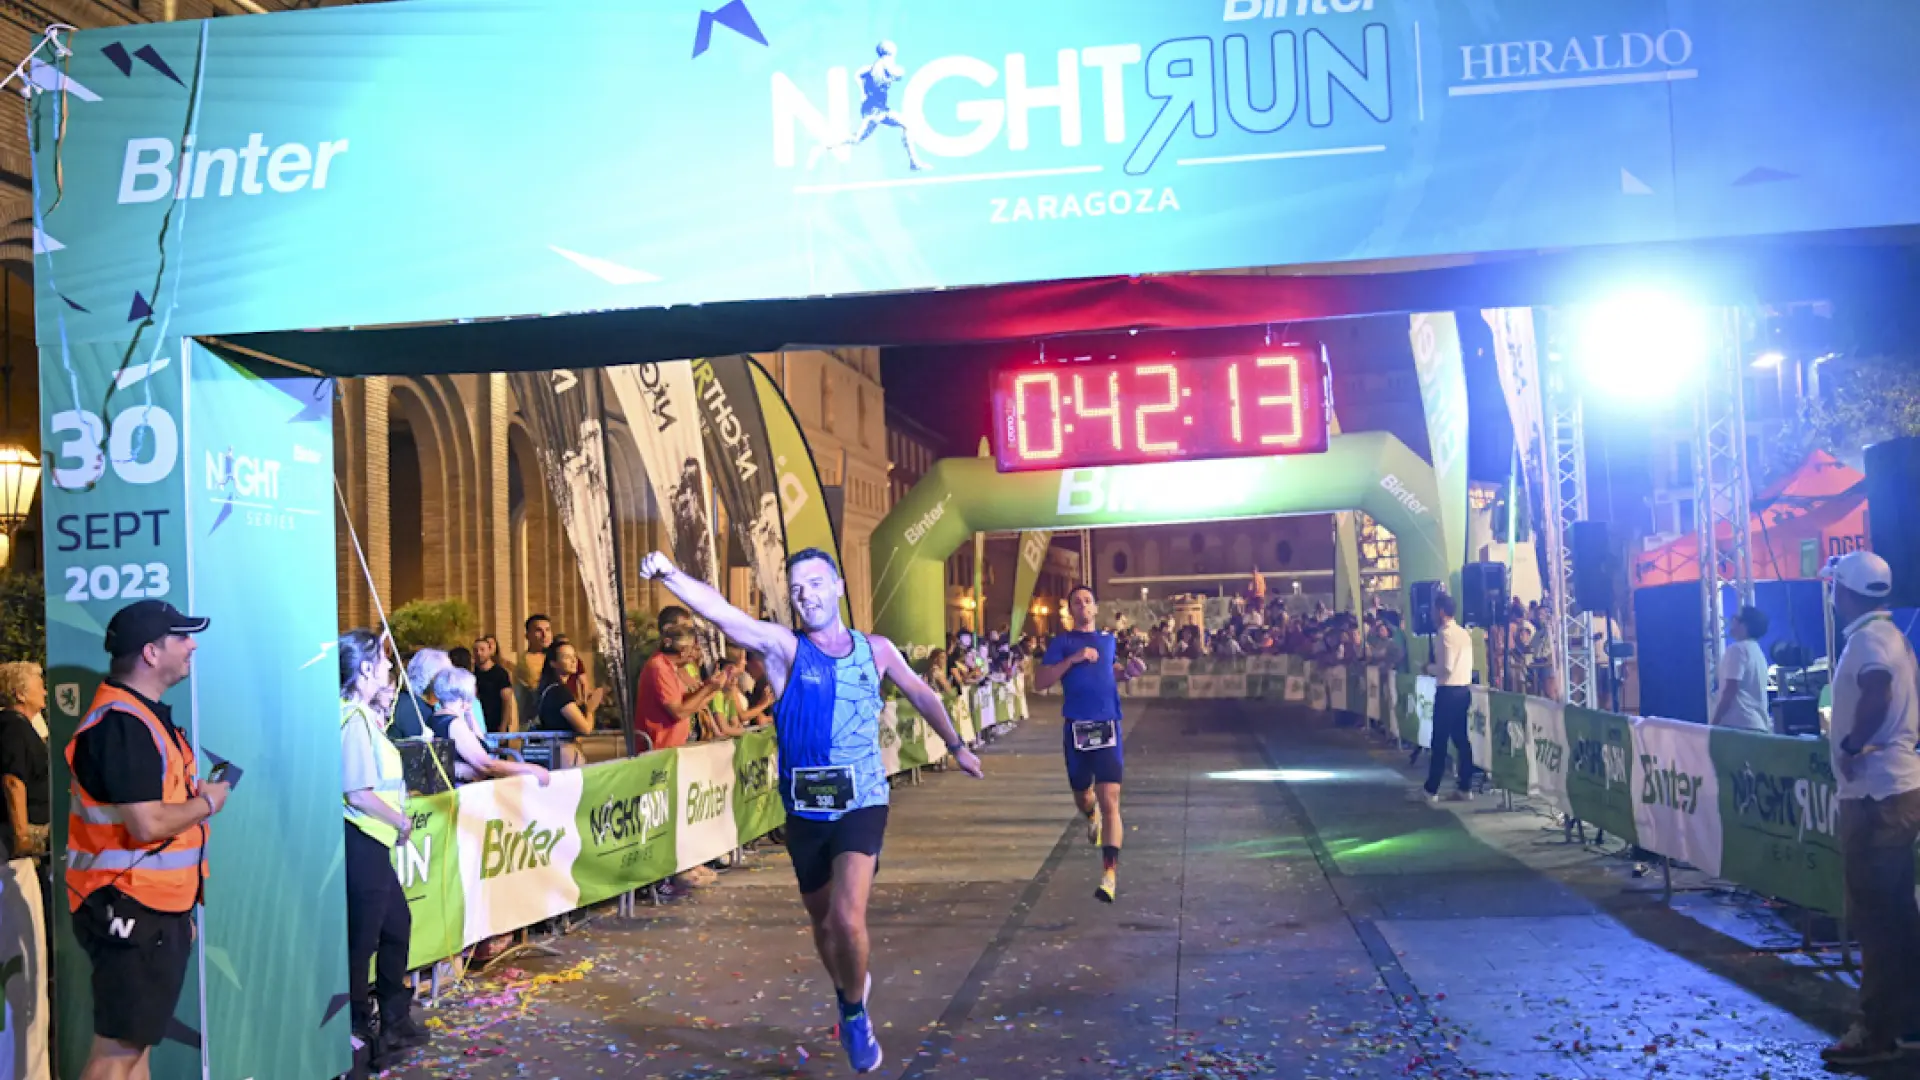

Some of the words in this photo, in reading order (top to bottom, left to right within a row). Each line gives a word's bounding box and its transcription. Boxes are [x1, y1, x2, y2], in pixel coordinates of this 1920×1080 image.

[1459, 29, 1693, 80] HERALDO
[117, 132, 348, 204] Binter
[989, 186, 1180, 223] ZARAGOZA
[51, 405, 178, 490] 30
[1380, 473, 1429, 514] Binter
[57, 509, 170, 551] SEPT
[904, 502, 945, 546] Binter
[65, 562, 170, 601] 2023
[688, 779, 728, 826] Binter
[1640, 754, 1703, 814] Binter
[480, 818, 566, 881] Binter
